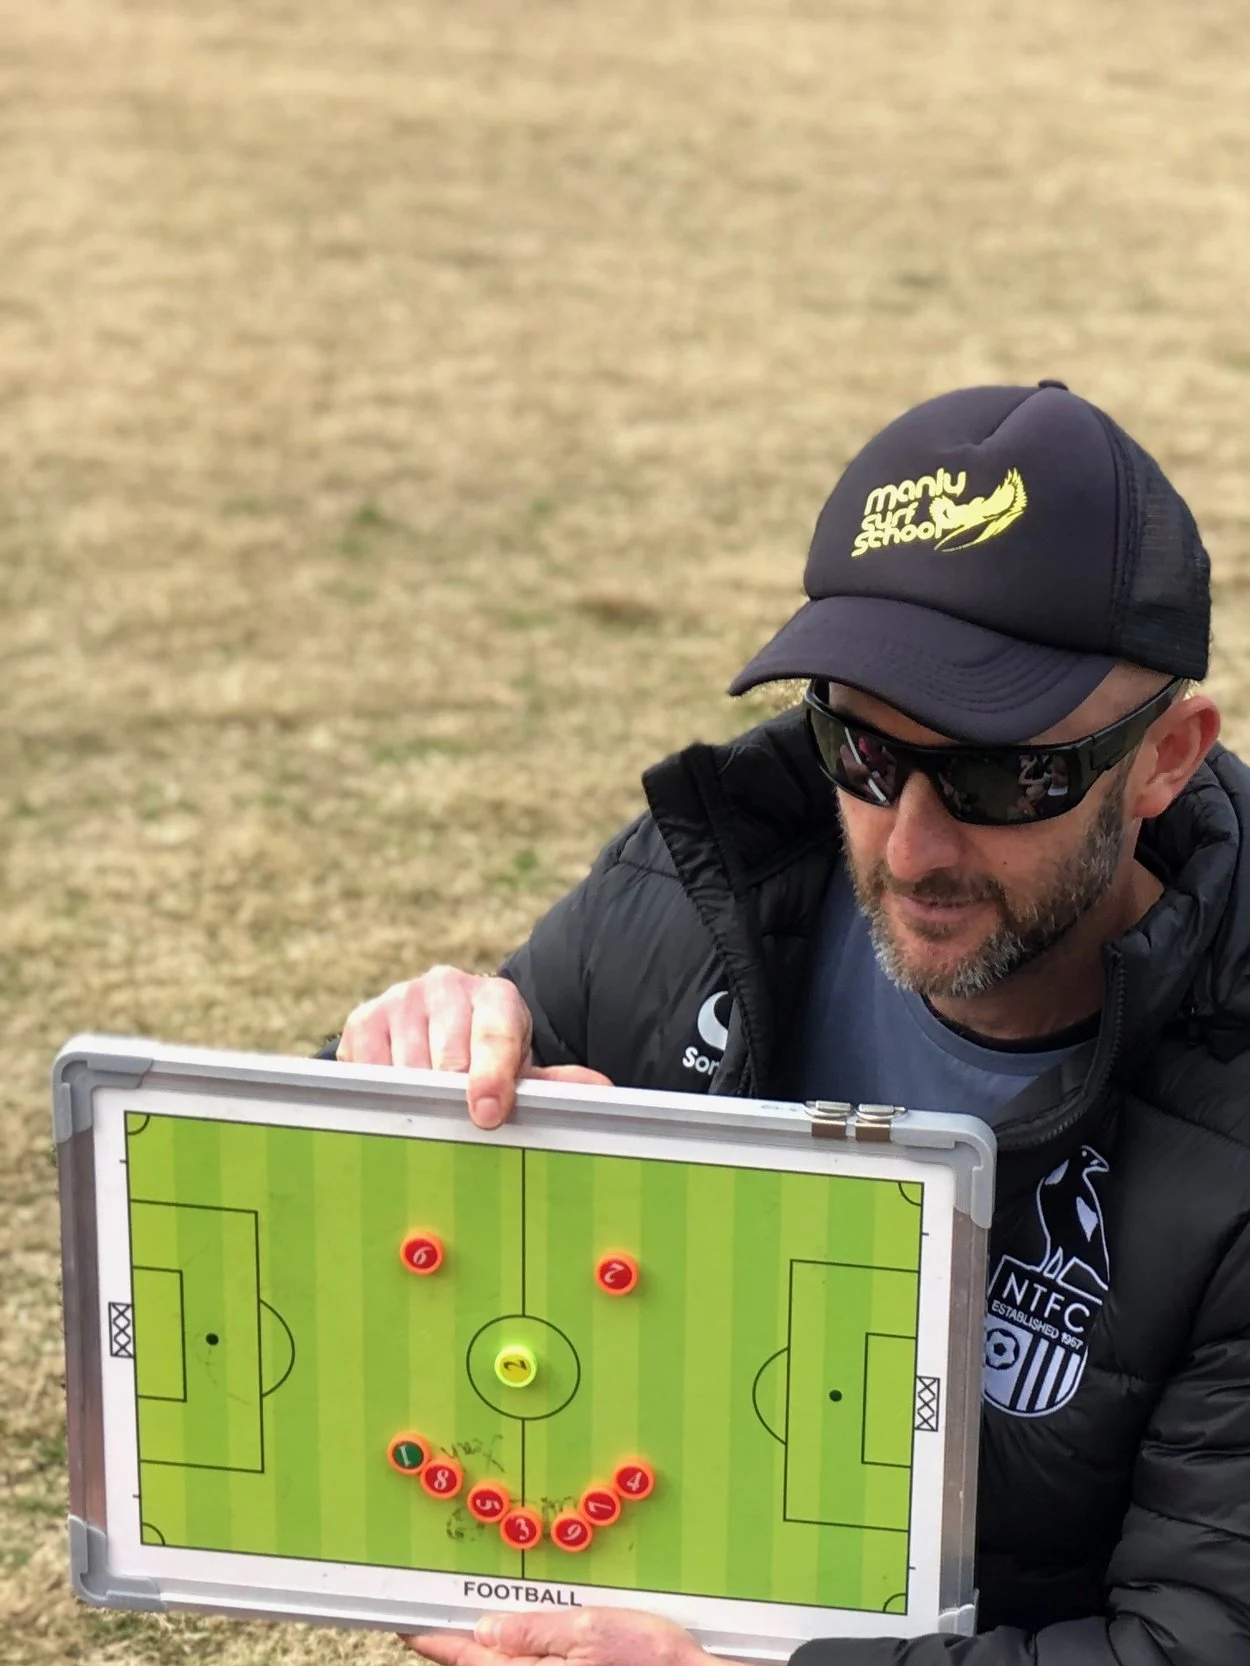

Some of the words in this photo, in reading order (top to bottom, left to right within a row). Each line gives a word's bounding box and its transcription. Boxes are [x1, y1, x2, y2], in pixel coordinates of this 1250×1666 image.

[864, 468, 967, 515] manly
[851, 517, 943, 557] school
[861, 502, 919, 533] surf
[991, 1300, 1060, 1339] ESTABLISHED
[1002, 1272, 1090, 1333] NTFC
[464, 1581, 582, 1607] FOOTBALL
